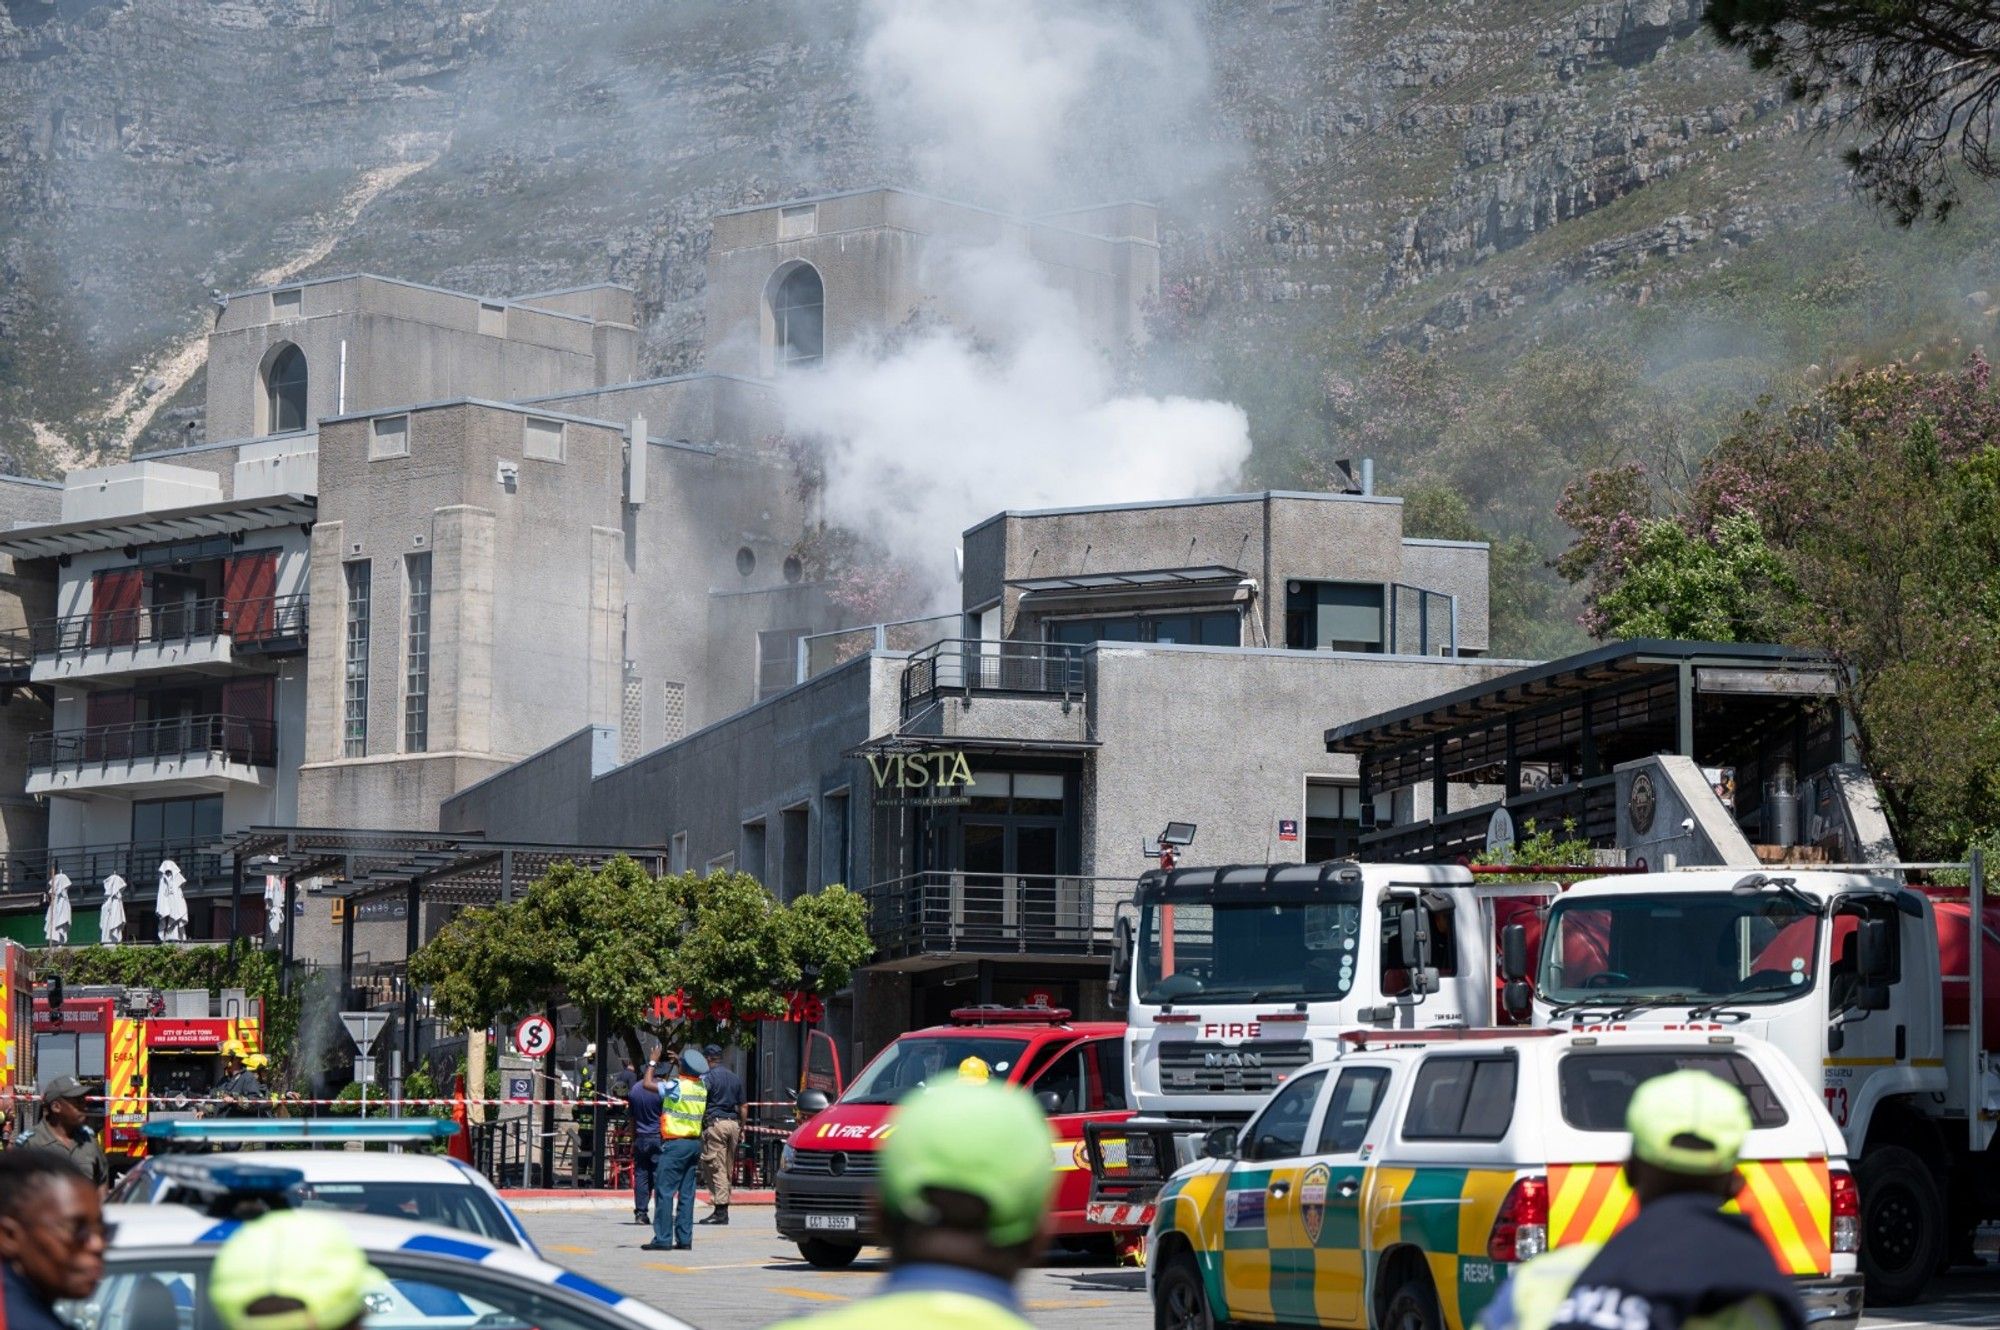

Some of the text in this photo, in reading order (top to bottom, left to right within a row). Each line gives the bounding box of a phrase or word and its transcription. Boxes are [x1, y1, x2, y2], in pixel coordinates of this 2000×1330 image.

[866, 751, 976, 788] VISTA
[932, 796, 970, 805] MOUNTAIN
[527, 1025, 543, 1048] S
[1205, 1023, 1262, 1038] FIRE
[1205, 1053, 1262, 1067] MAN
[1825, 1068, 1853, 1078] ISUZU
[836, 1125, 871, 1138] FIRE
